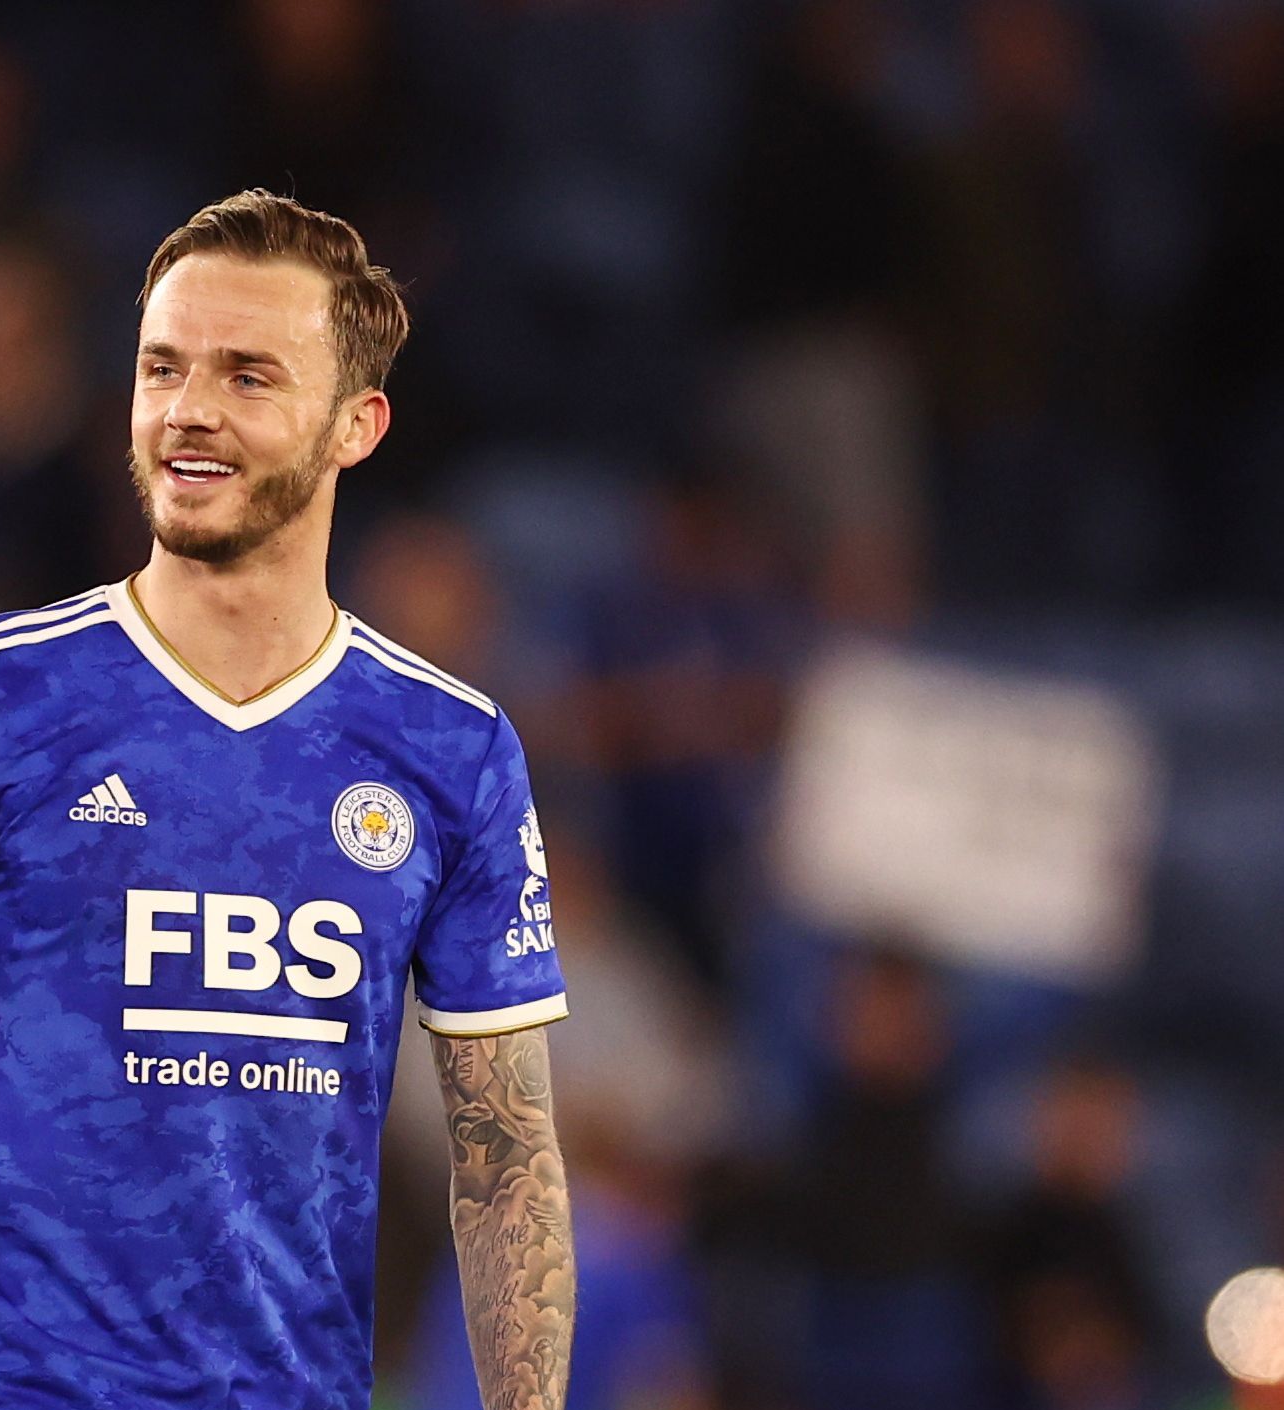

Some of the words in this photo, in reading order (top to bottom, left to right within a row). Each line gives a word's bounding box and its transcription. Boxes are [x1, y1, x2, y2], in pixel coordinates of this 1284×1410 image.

[69, 804, 148, 827] adidas
[342, 790, 392, 818] LEICESTER
[392, 802, 408, 829] CITY
[341, 825, 388, 863] FOOTBALL
[387, 835, 407, 861] CLUB
[124, 889, 363, 999] FBS
[123, 1051, 230, 1087] trade
[240, 1057, 341, 1096] online
